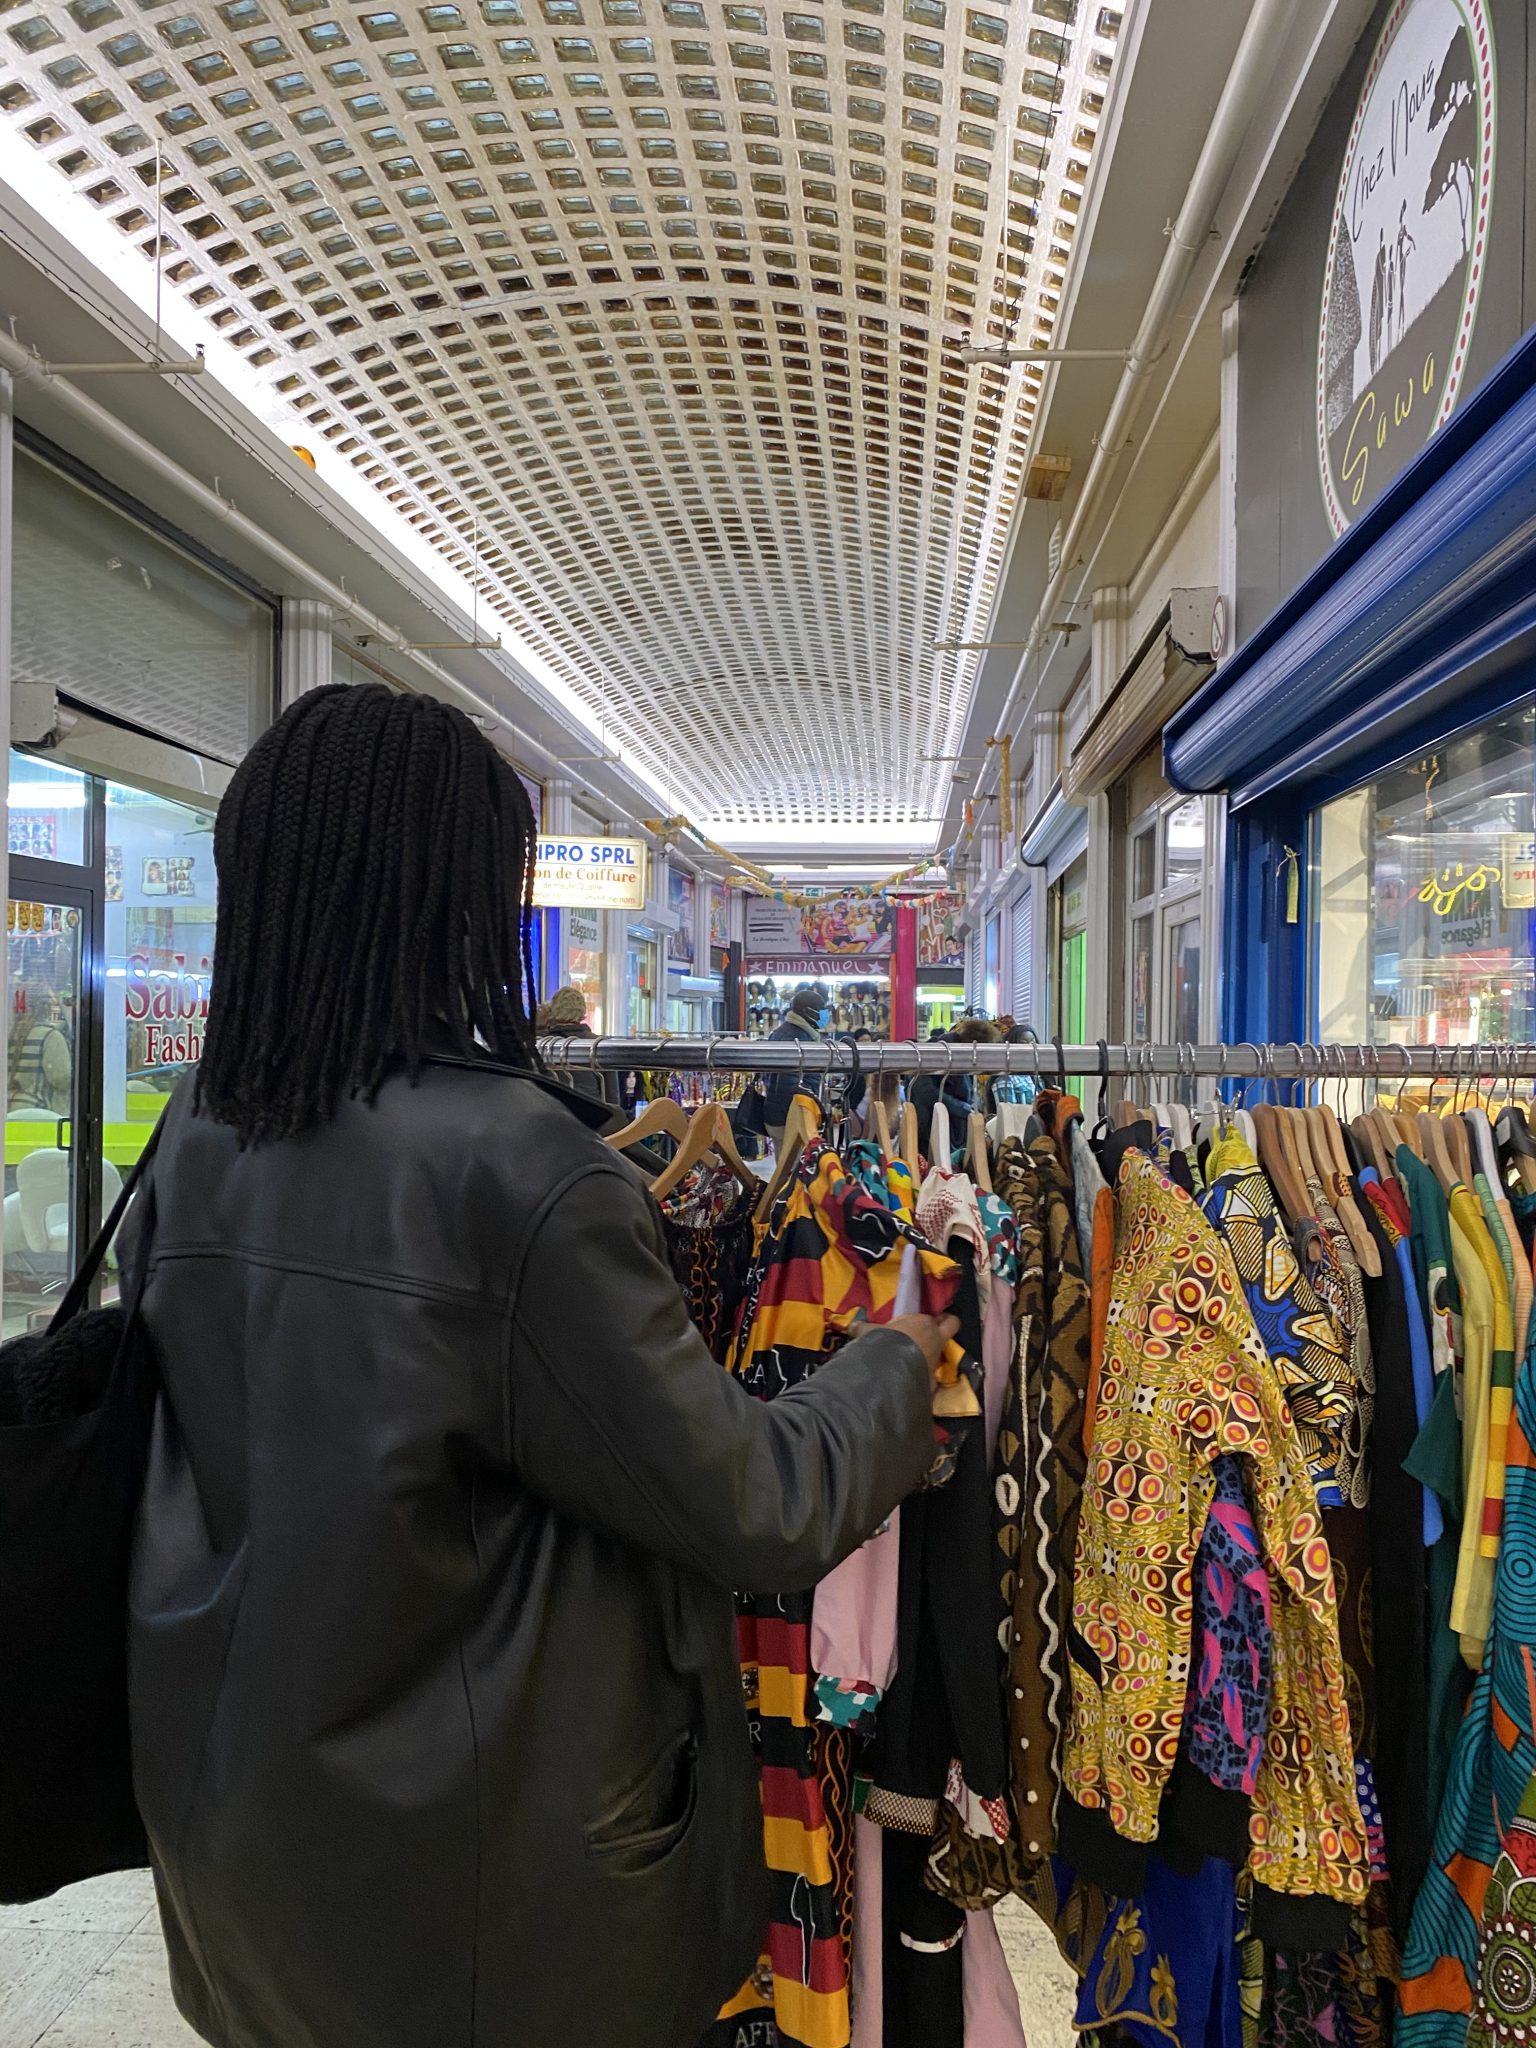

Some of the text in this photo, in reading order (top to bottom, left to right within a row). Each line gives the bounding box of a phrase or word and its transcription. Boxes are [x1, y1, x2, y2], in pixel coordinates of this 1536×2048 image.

[1353, 60, 1435, 243] Chez Nous
[1342, 352, 1434, 505] Sawa
[556, 867, 572, 880] de
[576, 867, 637, 883] Coiffure
[590, 846, 635, 865] SPRL
